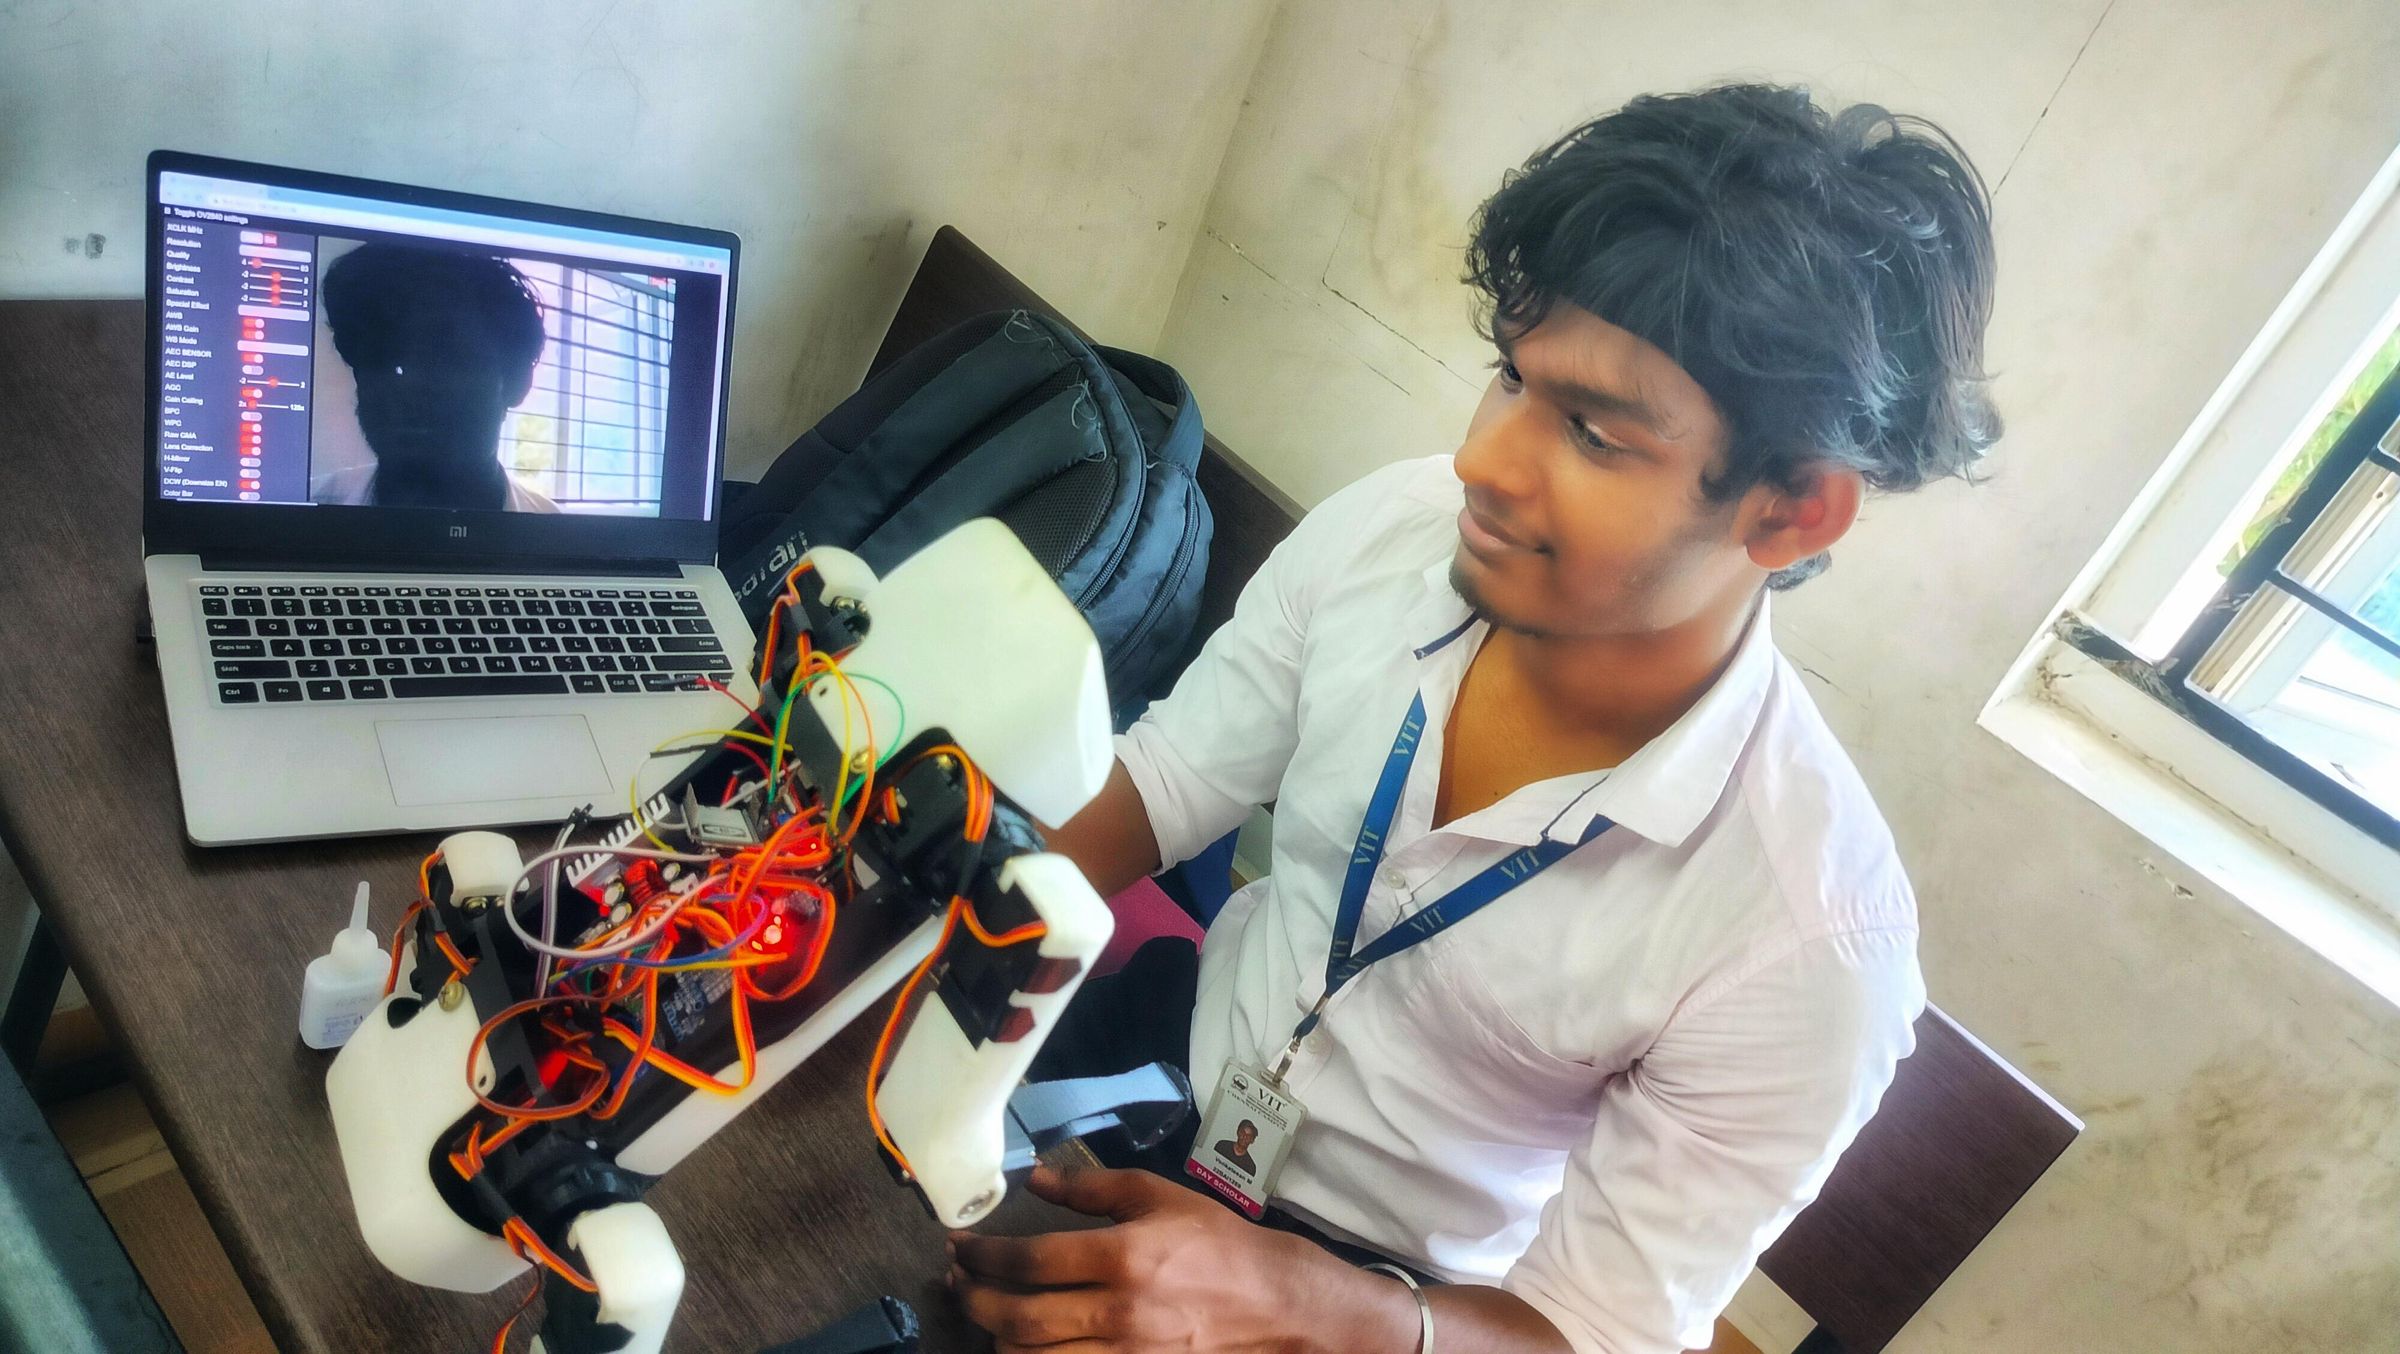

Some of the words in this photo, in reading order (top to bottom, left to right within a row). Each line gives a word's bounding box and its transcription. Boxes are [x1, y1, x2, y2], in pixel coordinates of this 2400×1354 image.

[166, 250, 190, 260] Quality
[166, 261, 201, 272] Brightness
[166, 275, 194, 284] Contrast
[166, 287, 199, 297] Saturation
[166, 299, 190, 310] Special
[191, 300, 210, 310] Effect
[165, 311, 183, 320] AWB
[165, 323, 183, 332] AWB
[183, 324, 199, 333] Gain
[179, 335, 197, 345] Mode
[165, 347, 181, 356] AEC
[182, 349, 212, 358] SENSOR
[165, 359, 181, 368] AEC
[182, 360, 197, 369] DSP
[165, 371, 175, 380] AE
[176, 372, 194, 380] Level
[164, 419, 182, 427] WPC
[164, 431, 179, 439] Raw
[164, 443, 180, 451] Lens
[181, 443, 214, 452] Correction
[163, 477, 181, 485] DCW
[163, 489, 181, 497] Color
[1393, 715, 1421, 757] VIT
[1354, 825, 1381, 866] VIT
[1500, 850, 1543, 880] VIT
[1409, 905, 1445, 935] VIT
[1258, 1087, 1285, 1112] VIT
[1196, 1166, 1213, 1181] DAY
[1214, 1179, 1250, 1208] SCHOLAR
